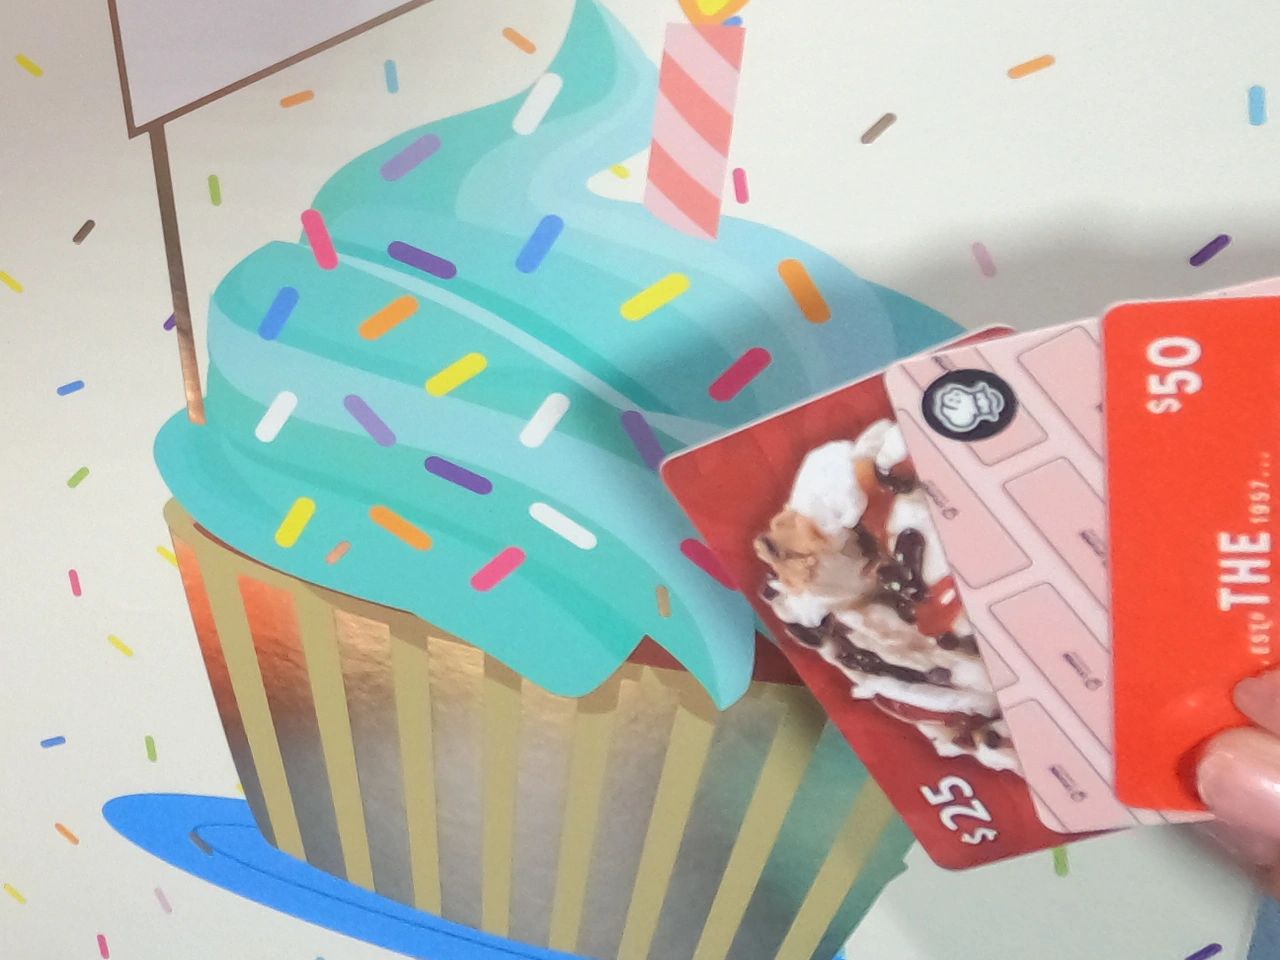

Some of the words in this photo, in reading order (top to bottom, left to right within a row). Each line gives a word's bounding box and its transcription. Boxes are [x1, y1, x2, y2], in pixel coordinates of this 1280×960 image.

[1146, 336, 1203, 415] $50
[1218, 532, 1271, 612] THE
[919, 775, 996, 844] $25
